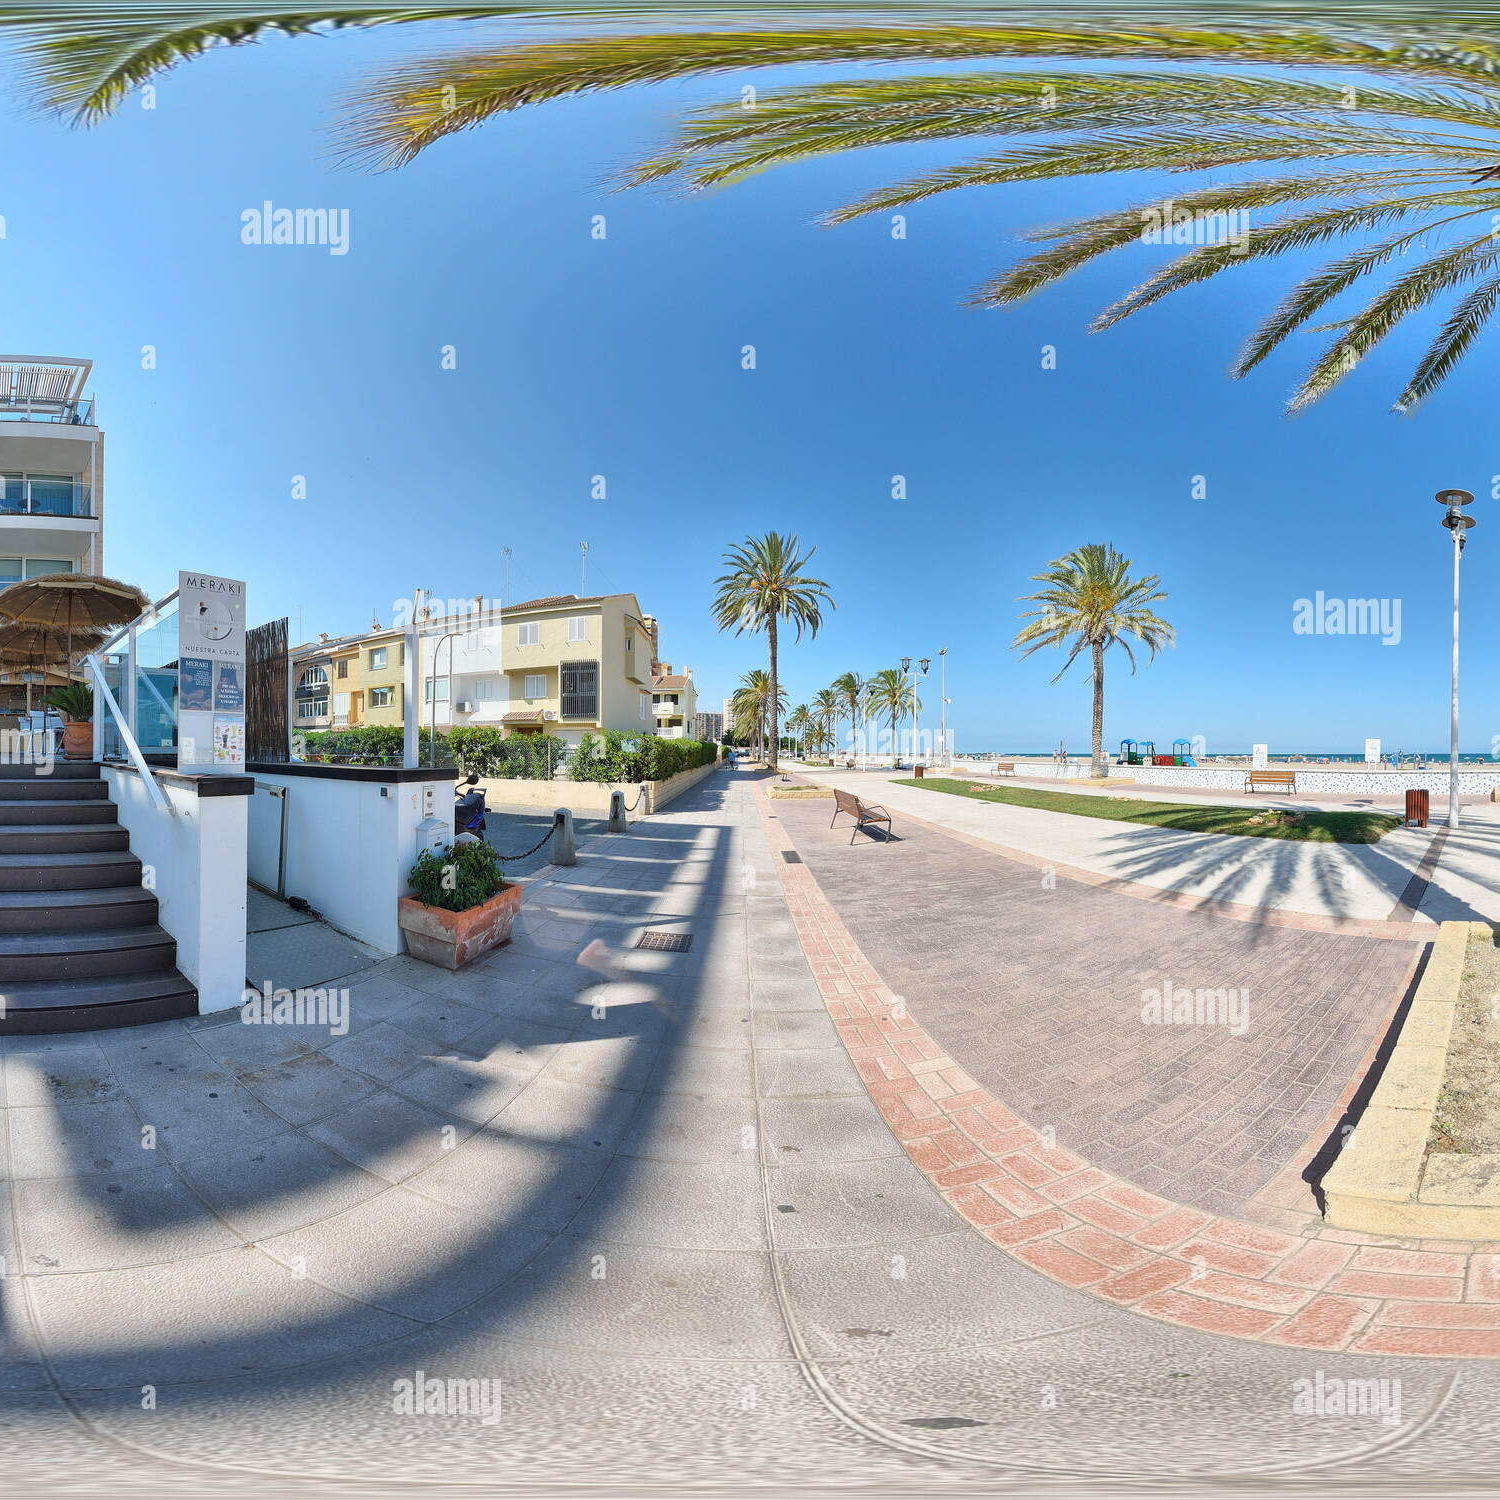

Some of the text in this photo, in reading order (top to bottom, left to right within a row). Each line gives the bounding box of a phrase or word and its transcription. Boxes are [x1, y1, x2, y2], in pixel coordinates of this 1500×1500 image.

[186, 577, 241, 594] MERAKI
[185, 645, 216, 654] NUESTRA
[185, 660, 209, 668] MERAKI
